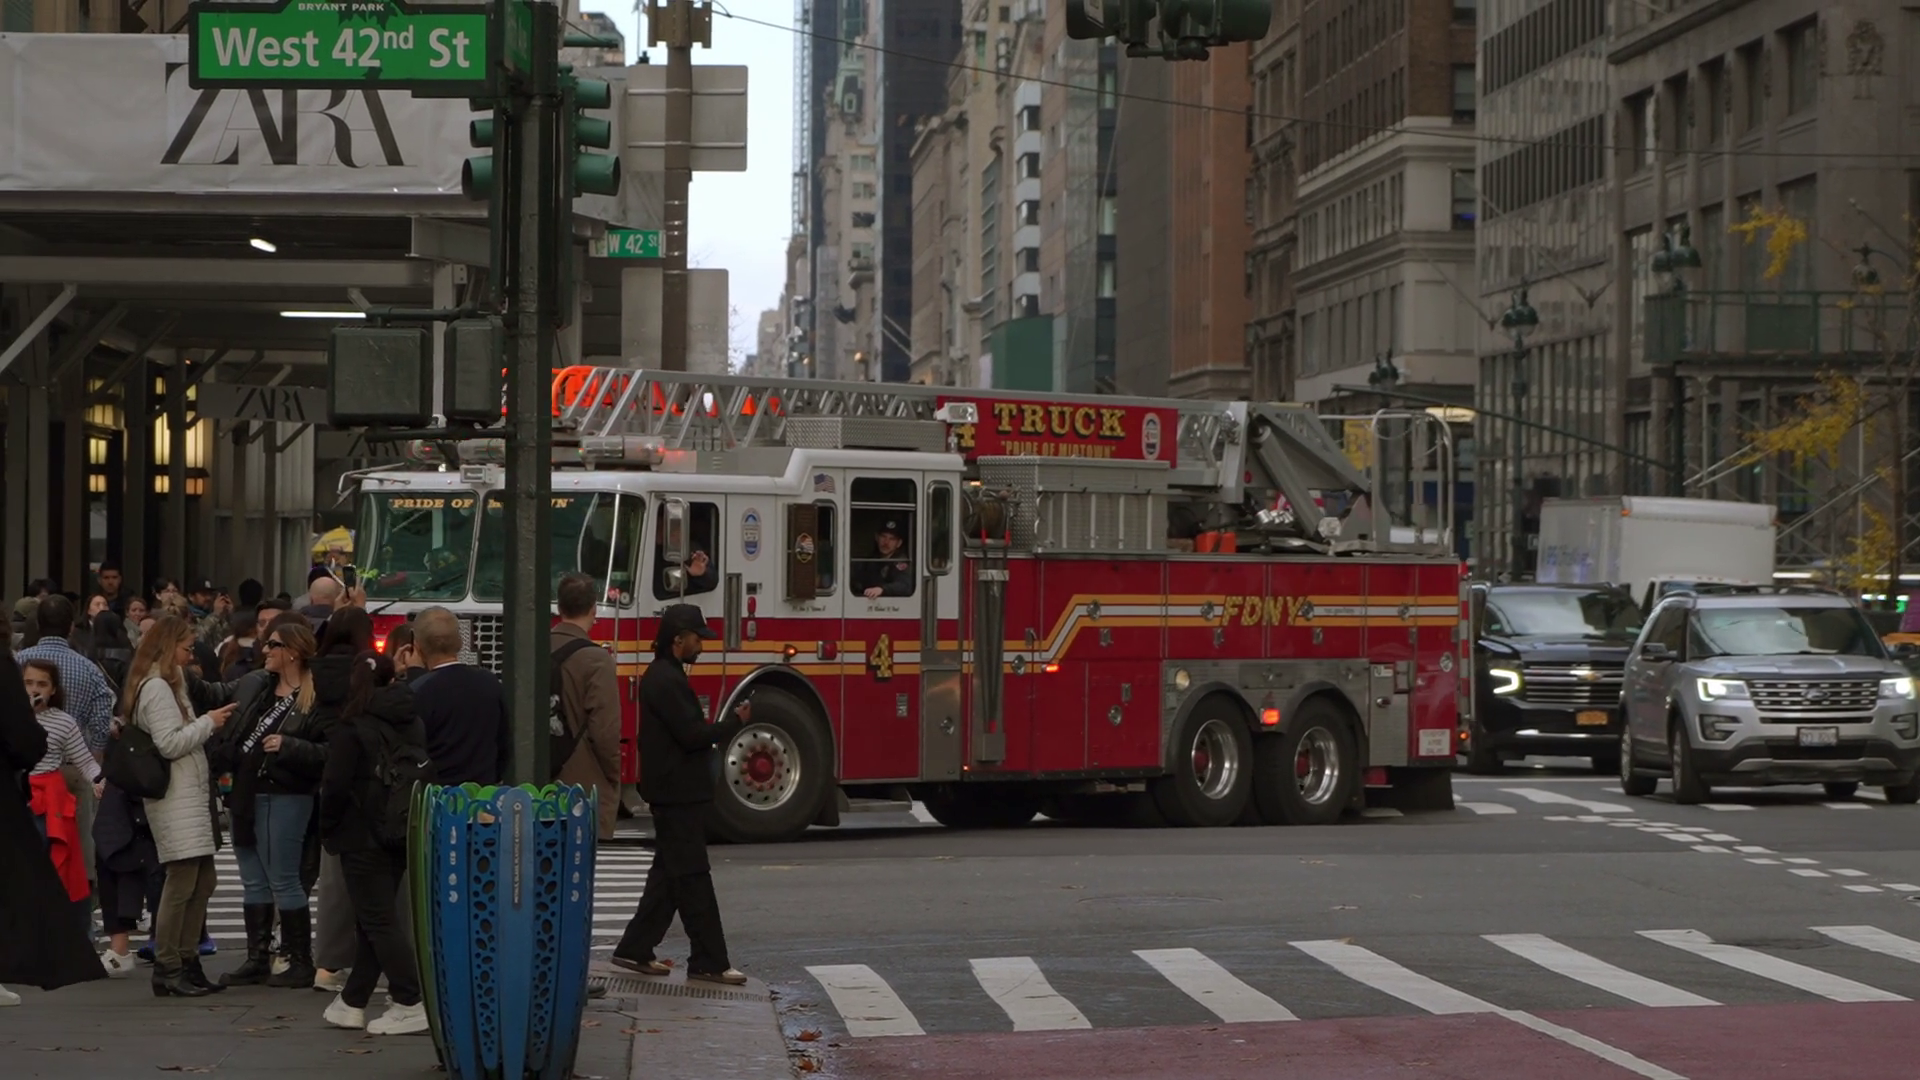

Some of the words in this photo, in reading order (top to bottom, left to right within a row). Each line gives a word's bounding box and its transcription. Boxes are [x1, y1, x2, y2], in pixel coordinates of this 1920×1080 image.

[298, 2, 347, 12] BRYANT
[351, 3, 385, 12] PARK
[212, 27, 320, 68] West
[331, 24, 414, 68] 42nd
[428, 27, 470, 69] St
[160, 62, 418, 168] ZARA
[608, 233, 621, 254] W
[625, 233, 644, 254] 42
[234, 387, 306, 421] ZARA
[994, 403, 1126, 438] TRUCK
[1042, 442, 1055, 457] OF
[389, 498, 445, 509] "PRIDE
[451, 498, 474, 509] OF
[1221, 595, 1307, 627] FDNY
[869, 633, 893, 679] 4
